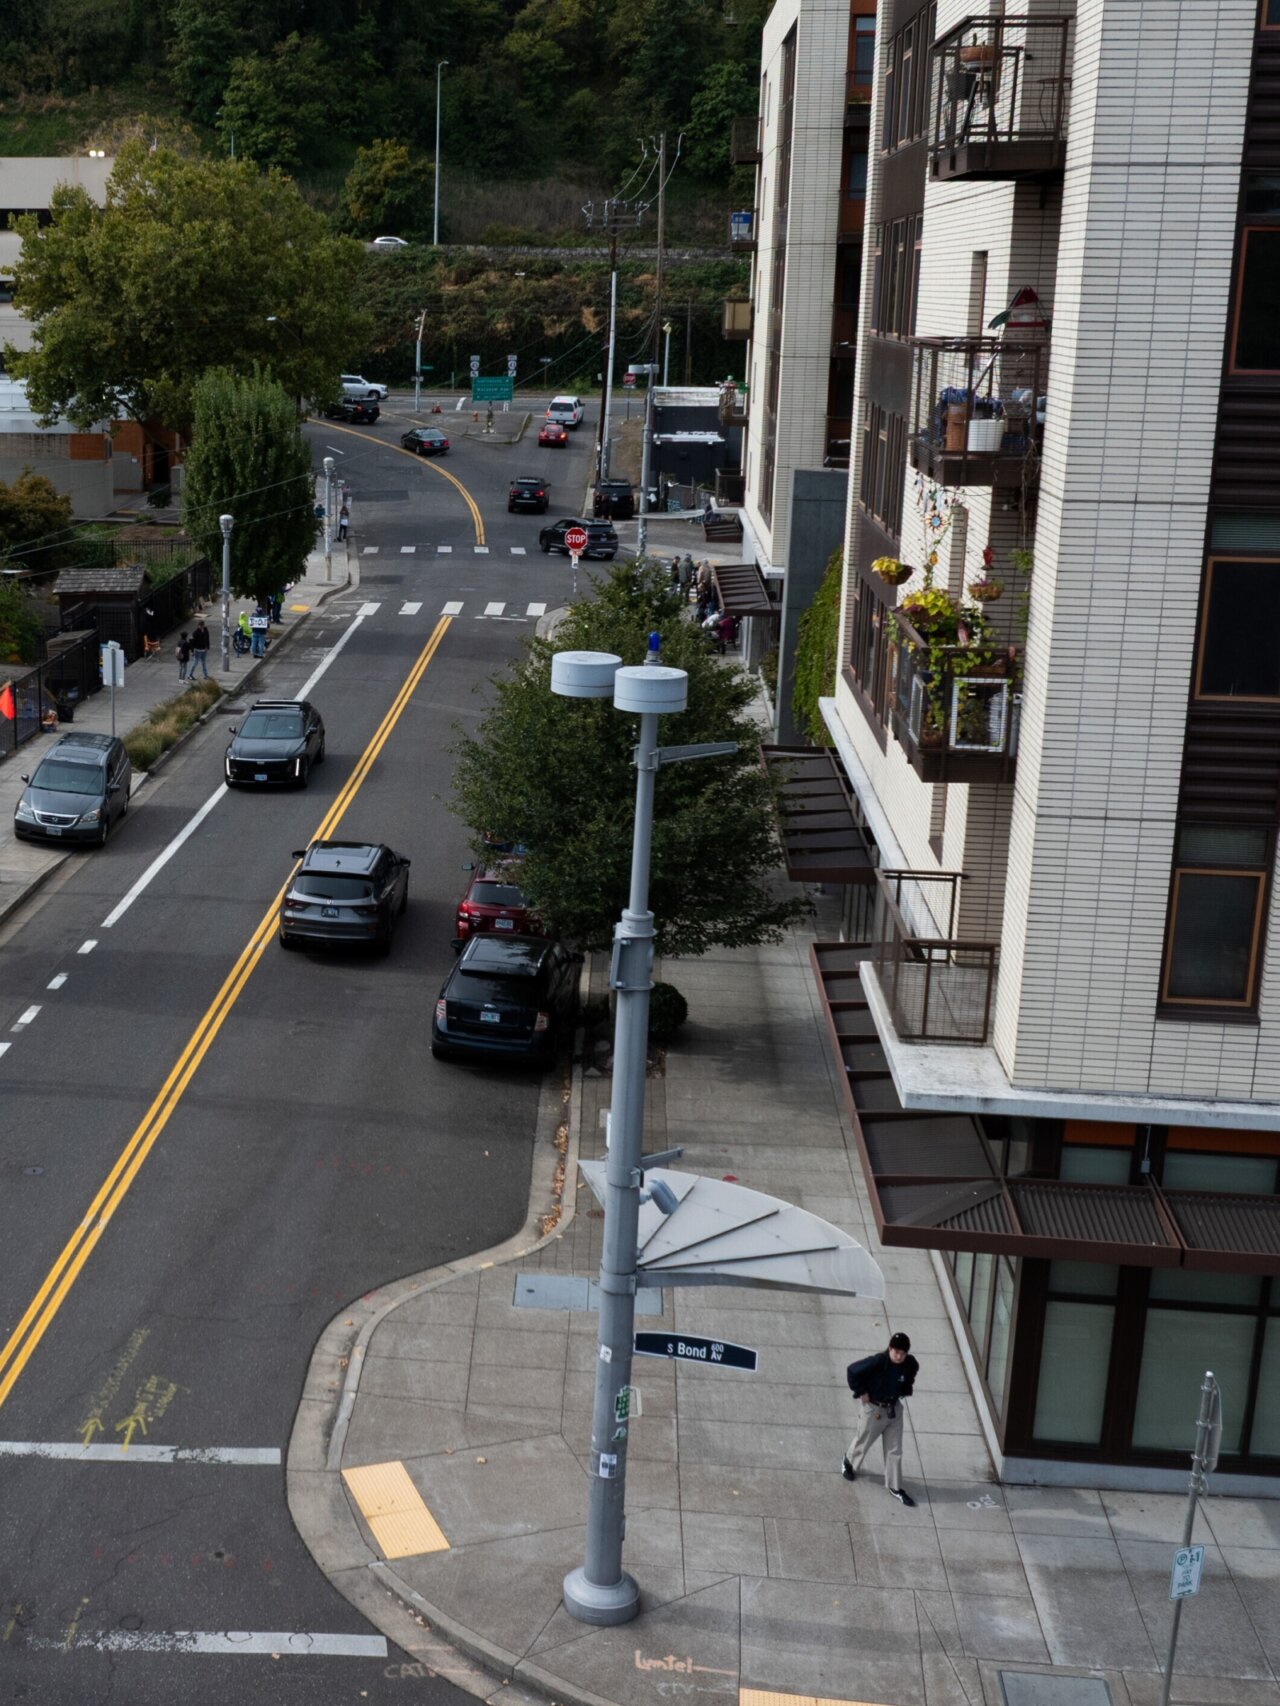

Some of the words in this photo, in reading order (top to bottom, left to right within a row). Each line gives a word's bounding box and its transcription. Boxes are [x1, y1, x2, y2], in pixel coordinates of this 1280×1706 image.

[567, 534, 586, 543] STOP
[667, 1343, 673, 1353] S
[677, 1342, 706, 1358] Bond
[711, 1351, 722, 1360] Av
